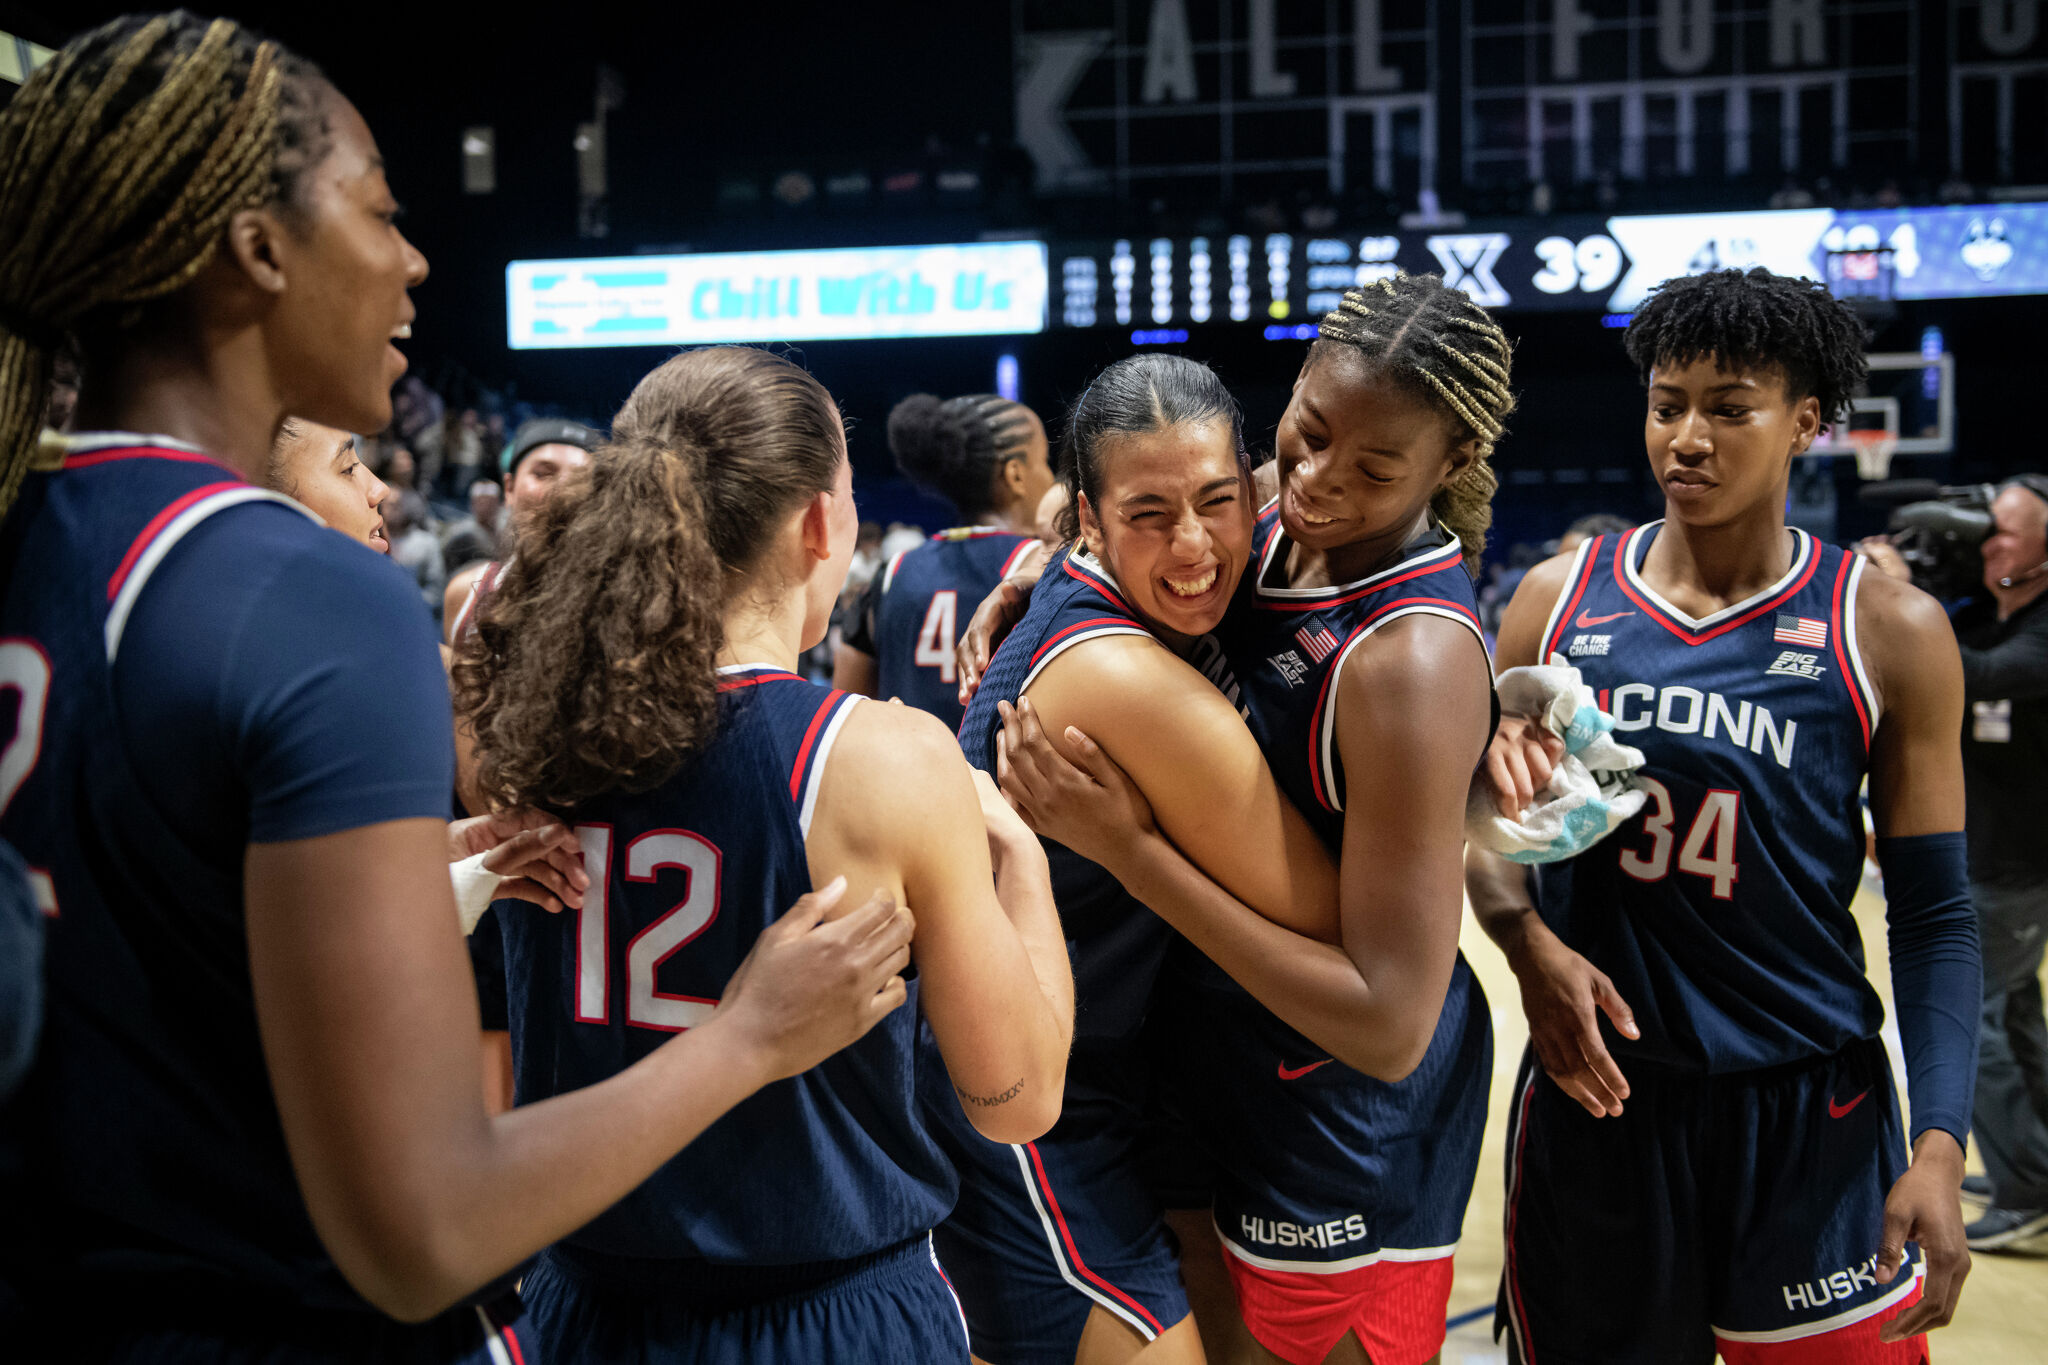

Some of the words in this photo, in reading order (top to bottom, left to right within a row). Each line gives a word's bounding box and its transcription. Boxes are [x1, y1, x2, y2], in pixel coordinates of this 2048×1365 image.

[1532, 234, 1623, 294] 39
[689, 275, 803, 321] Chill
[817, 269, 938, 317] With
[951, 269, 1016, 313] Us
[915, 589, 957, 683] 4
[1285, 649, 1309, 673] BIG
[1569, 644, 1611, 657] CHANGE
[1573, 634, 1590, 645] BE
[1590, 634, 1612, 645] THE
[1777, 651, 1818, 665] BIG
[1272, 653, 1305, 685] EAST
[1769, 660, 1827, 677] EAST
[1599, 683, 1797, 768] CONN
[1619, 777, 1741, 900] 34
[574, 822, 723, 1034] 12
[1241, 1194, 1368, 1248] HUSKIES
[1782, 1248, 1911, 1311] HUSK
